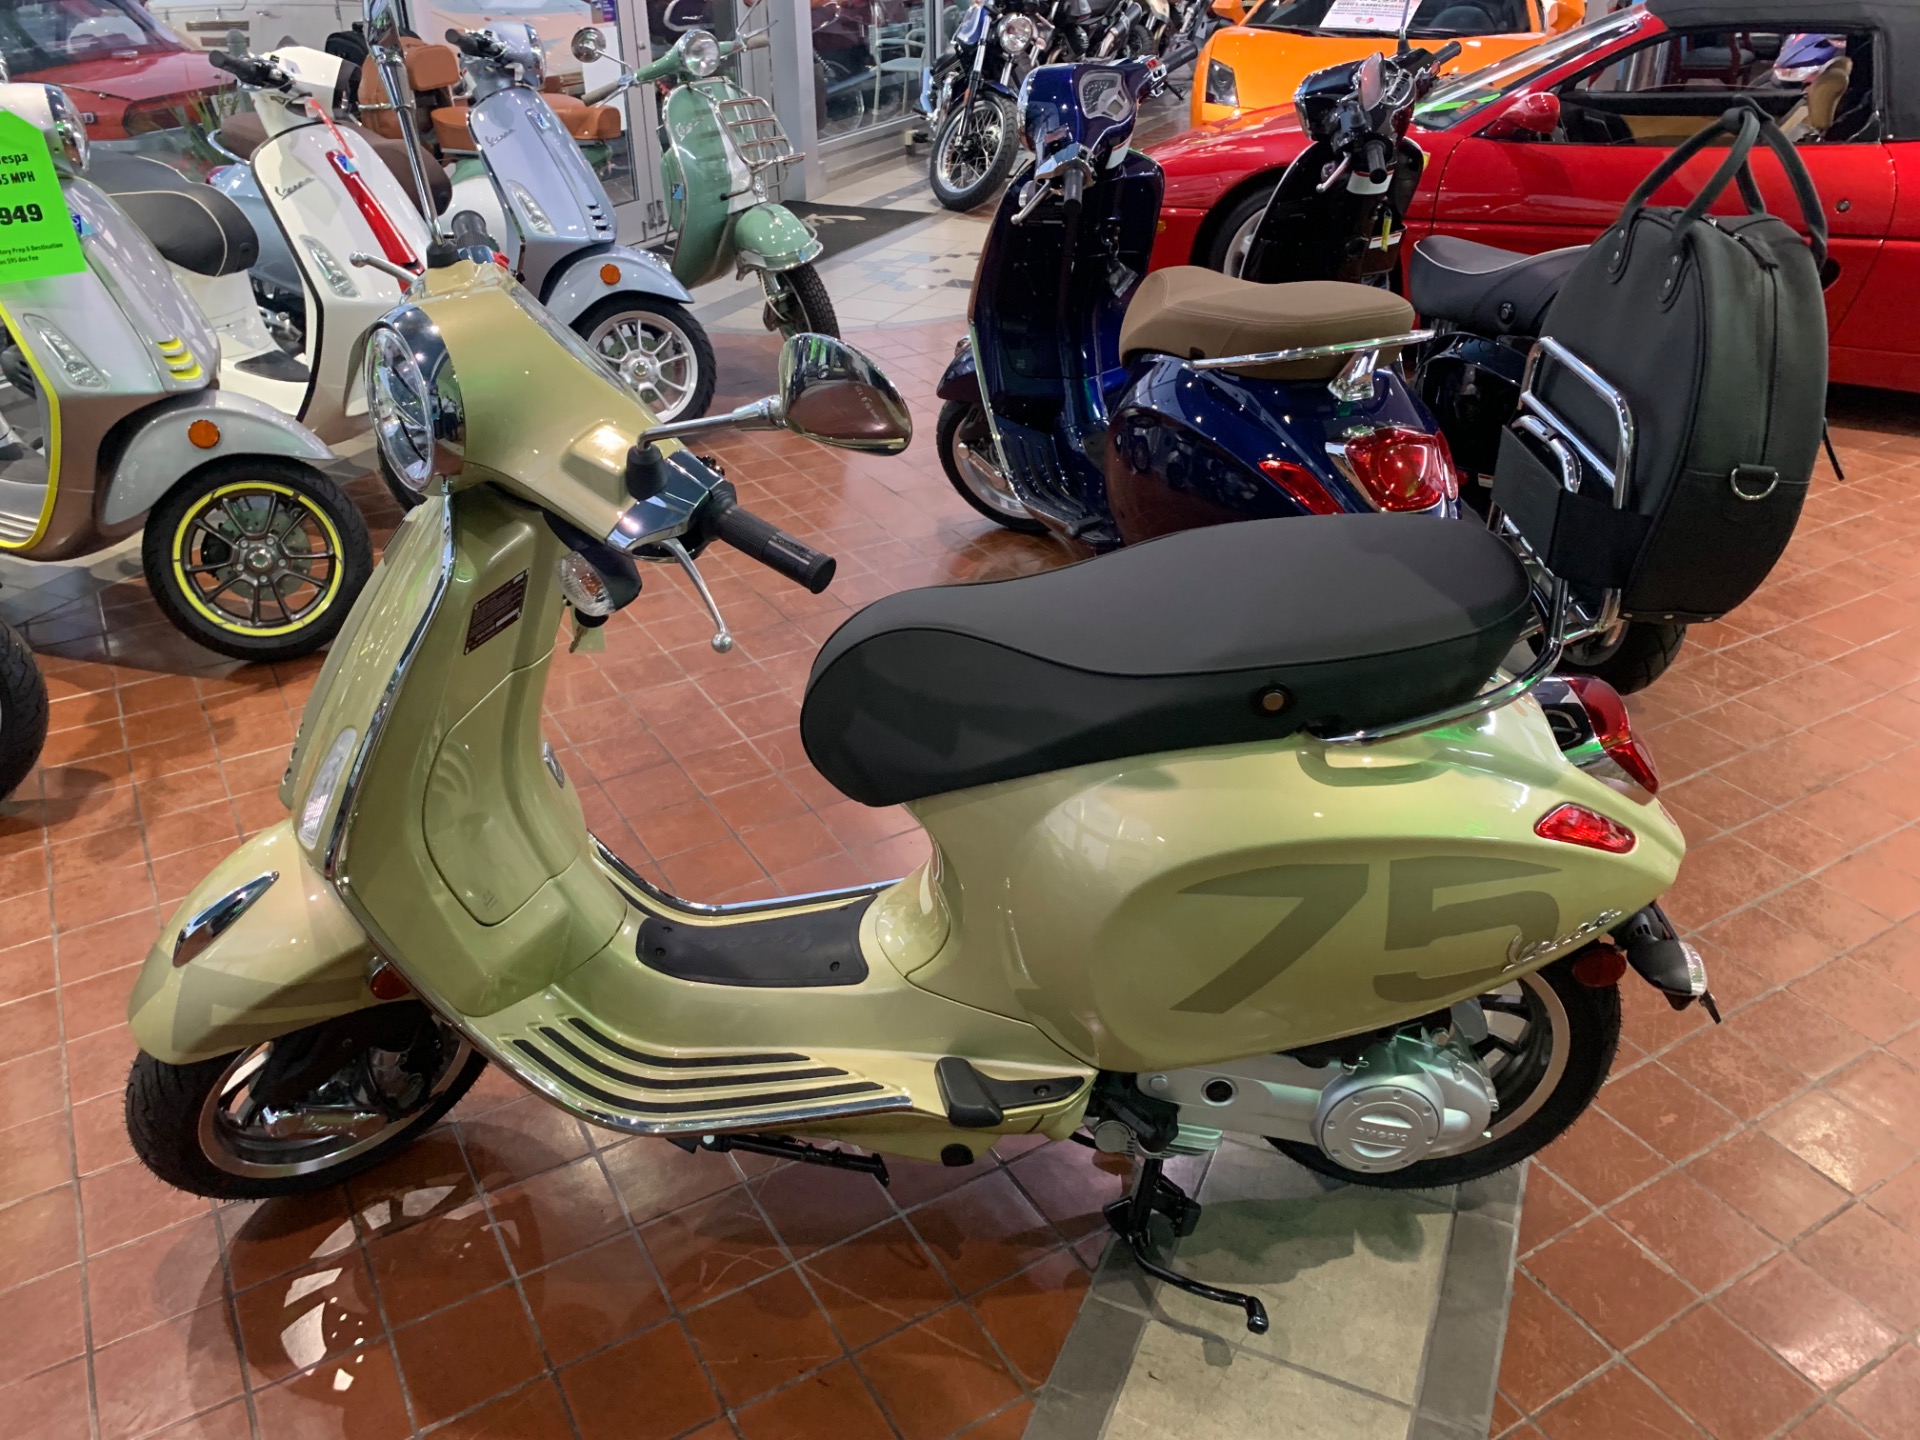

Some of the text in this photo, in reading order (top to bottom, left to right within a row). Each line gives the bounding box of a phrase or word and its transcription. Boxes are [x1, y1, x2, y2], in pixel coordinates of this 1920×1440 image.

[0, 153, 29, 166] espa
[10, 170, 36, 184] MPH
[1168, 855, 1563, 1015] 75
